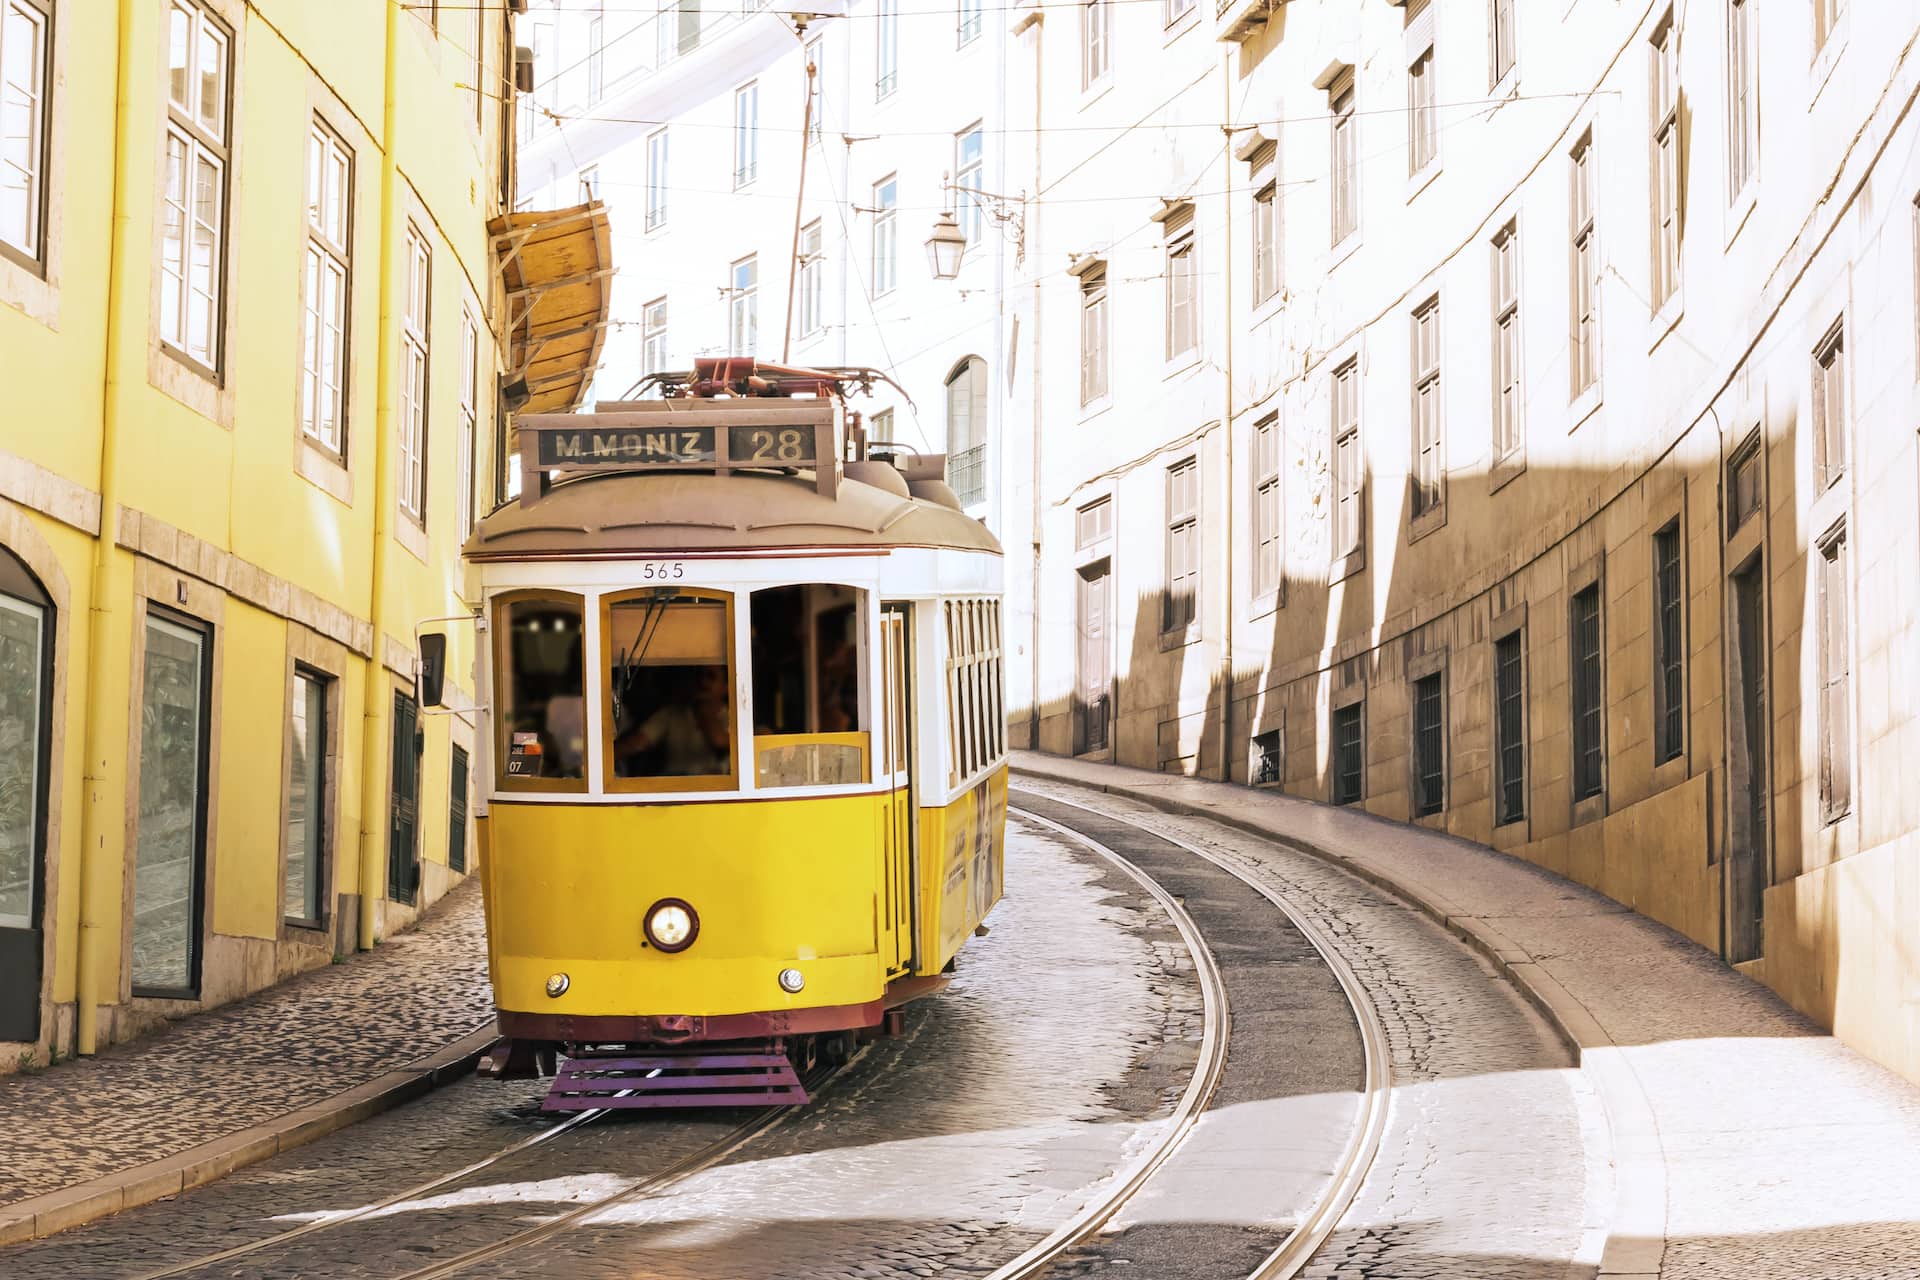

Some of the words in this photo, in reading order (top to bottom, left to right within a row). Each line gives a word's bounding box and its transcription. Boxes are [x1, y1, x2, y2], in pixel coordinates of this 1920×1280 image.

[751, 429, 802, 462] 28
[643, 562, 684, 579] 565
[509, 761, 522, 773] 07
